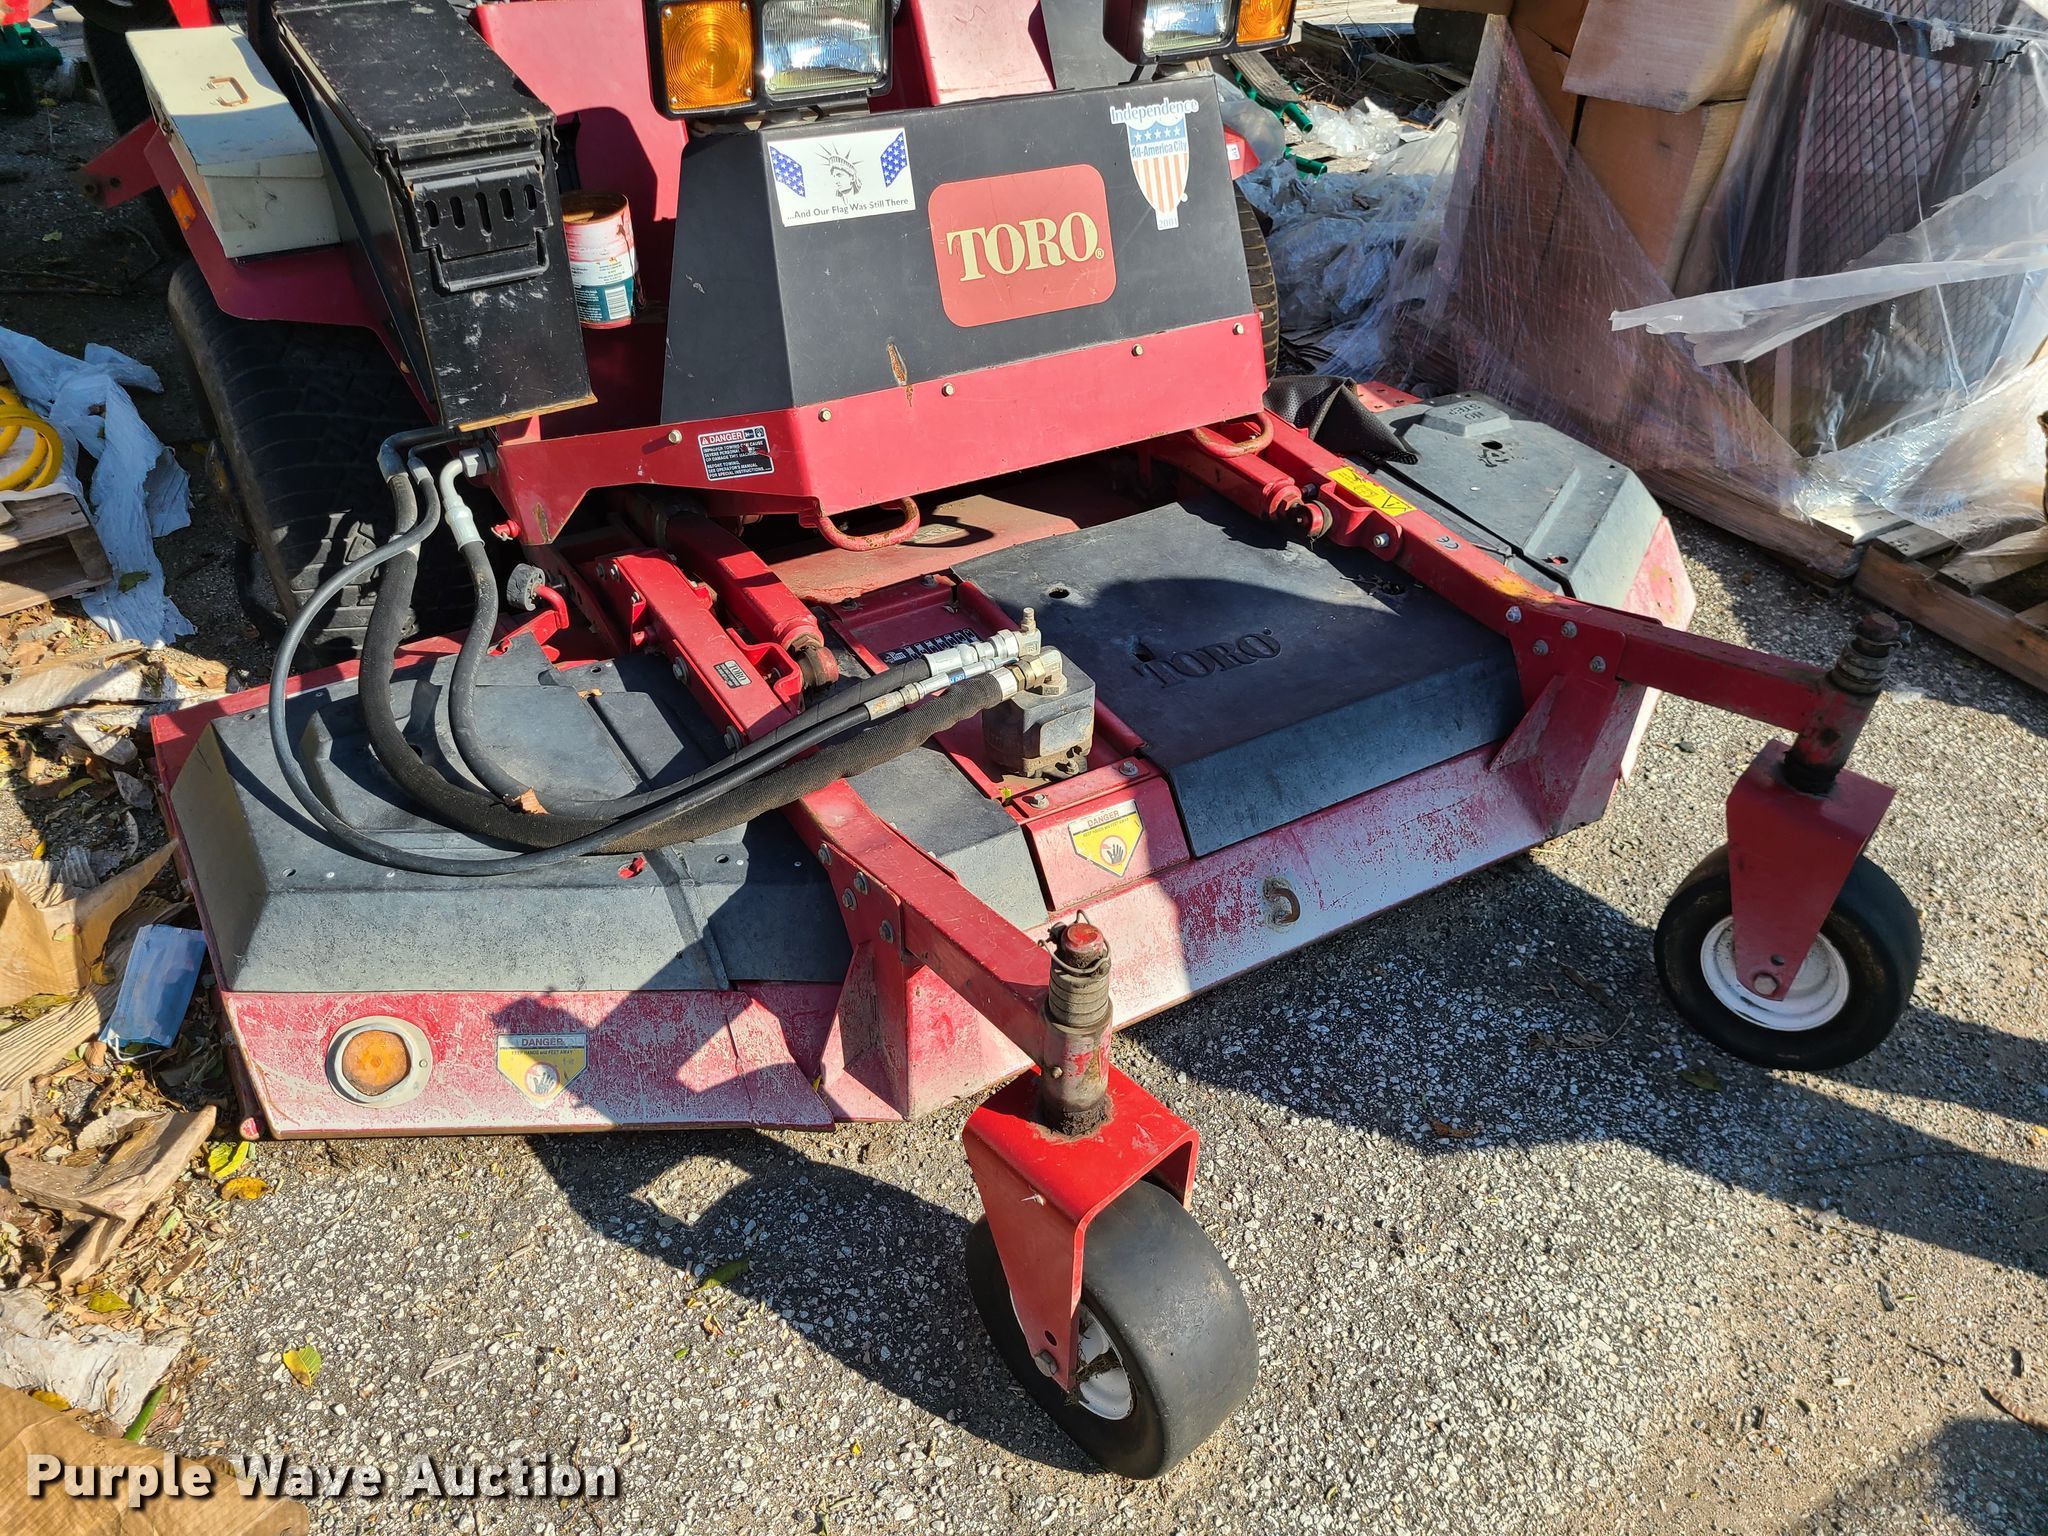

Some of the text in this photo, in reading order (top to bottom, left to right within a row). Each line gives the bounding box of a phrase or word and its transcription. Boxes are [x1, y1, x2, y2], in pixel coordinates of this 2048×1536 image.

[1111, 98, 1198, 123] Independence
[1131, 140, 1187, 158] All-America City
[813, 207, 829, 217] Our
[832, 204, 849, 214] Flag
[849, 202, 867, 211] Was
[869, 199, 885, 209] Still
[885, 198, 909, 207] There
[1158, 217, 1178, 229] 2001
[709, 431, 743, 444] DANGER
[717, 469, 735, 477] SPECIAL
[1087, 809, 1120, 827] DANGER
[521, 1038, 565, 1047] DANGER
